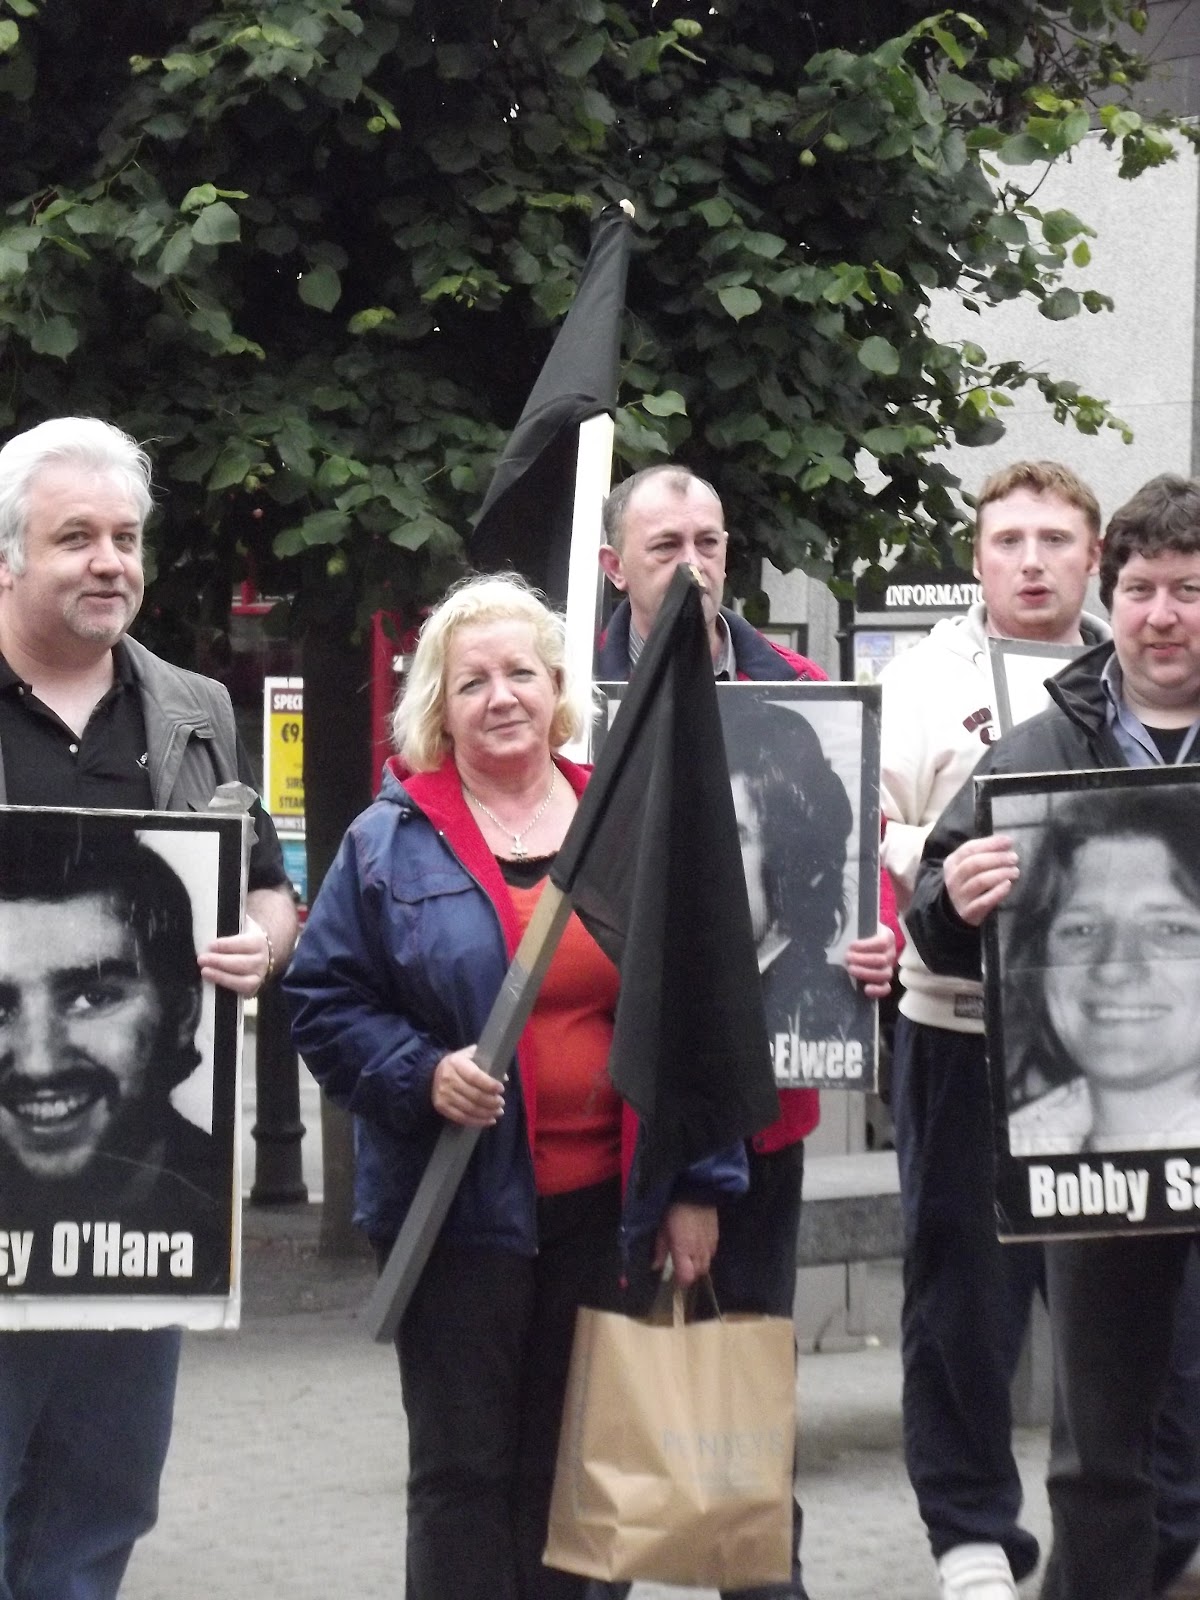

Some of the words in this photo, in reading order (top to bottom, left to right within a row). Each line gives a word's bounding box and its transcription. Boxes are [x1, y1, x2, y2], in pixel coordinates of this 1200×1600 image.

[769, 1032, 863, 1079] Elwee
[1028, 1161, 1149, 1223] Bobby
[52, 1221, 193, 1278] O'Hara
